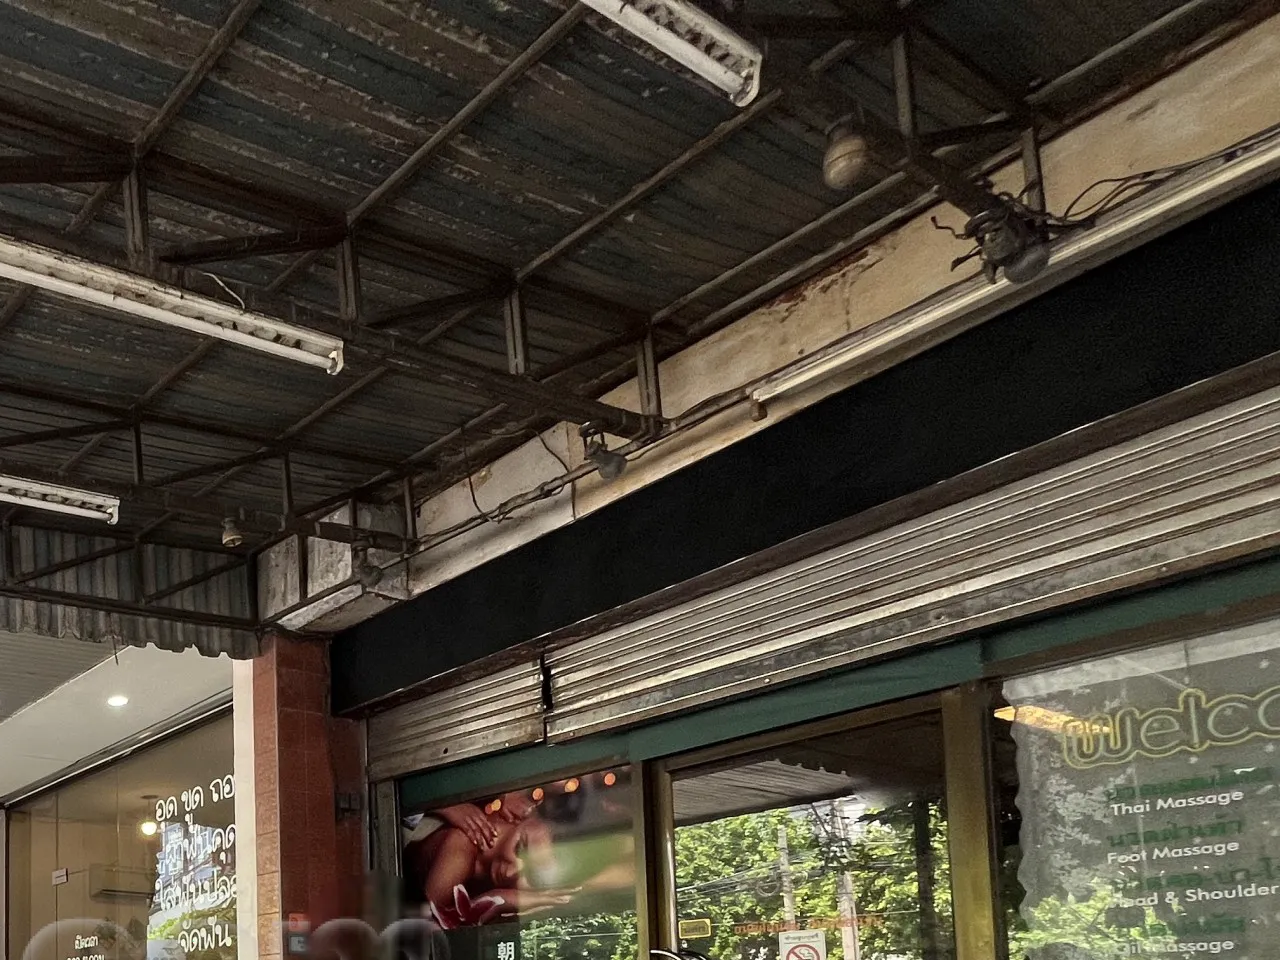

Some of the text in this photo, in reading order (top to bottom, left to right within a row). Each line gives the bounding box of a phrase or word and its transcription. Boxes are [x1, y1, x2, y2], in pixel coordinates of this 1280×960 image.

[1111, 790, 1244, 815] Thai Massage
[1107, 841, 1239, 864] Foot Massage
[1185, 884, 1280, 903] Shoulder
[1146, 940, 1235, 954] assage
